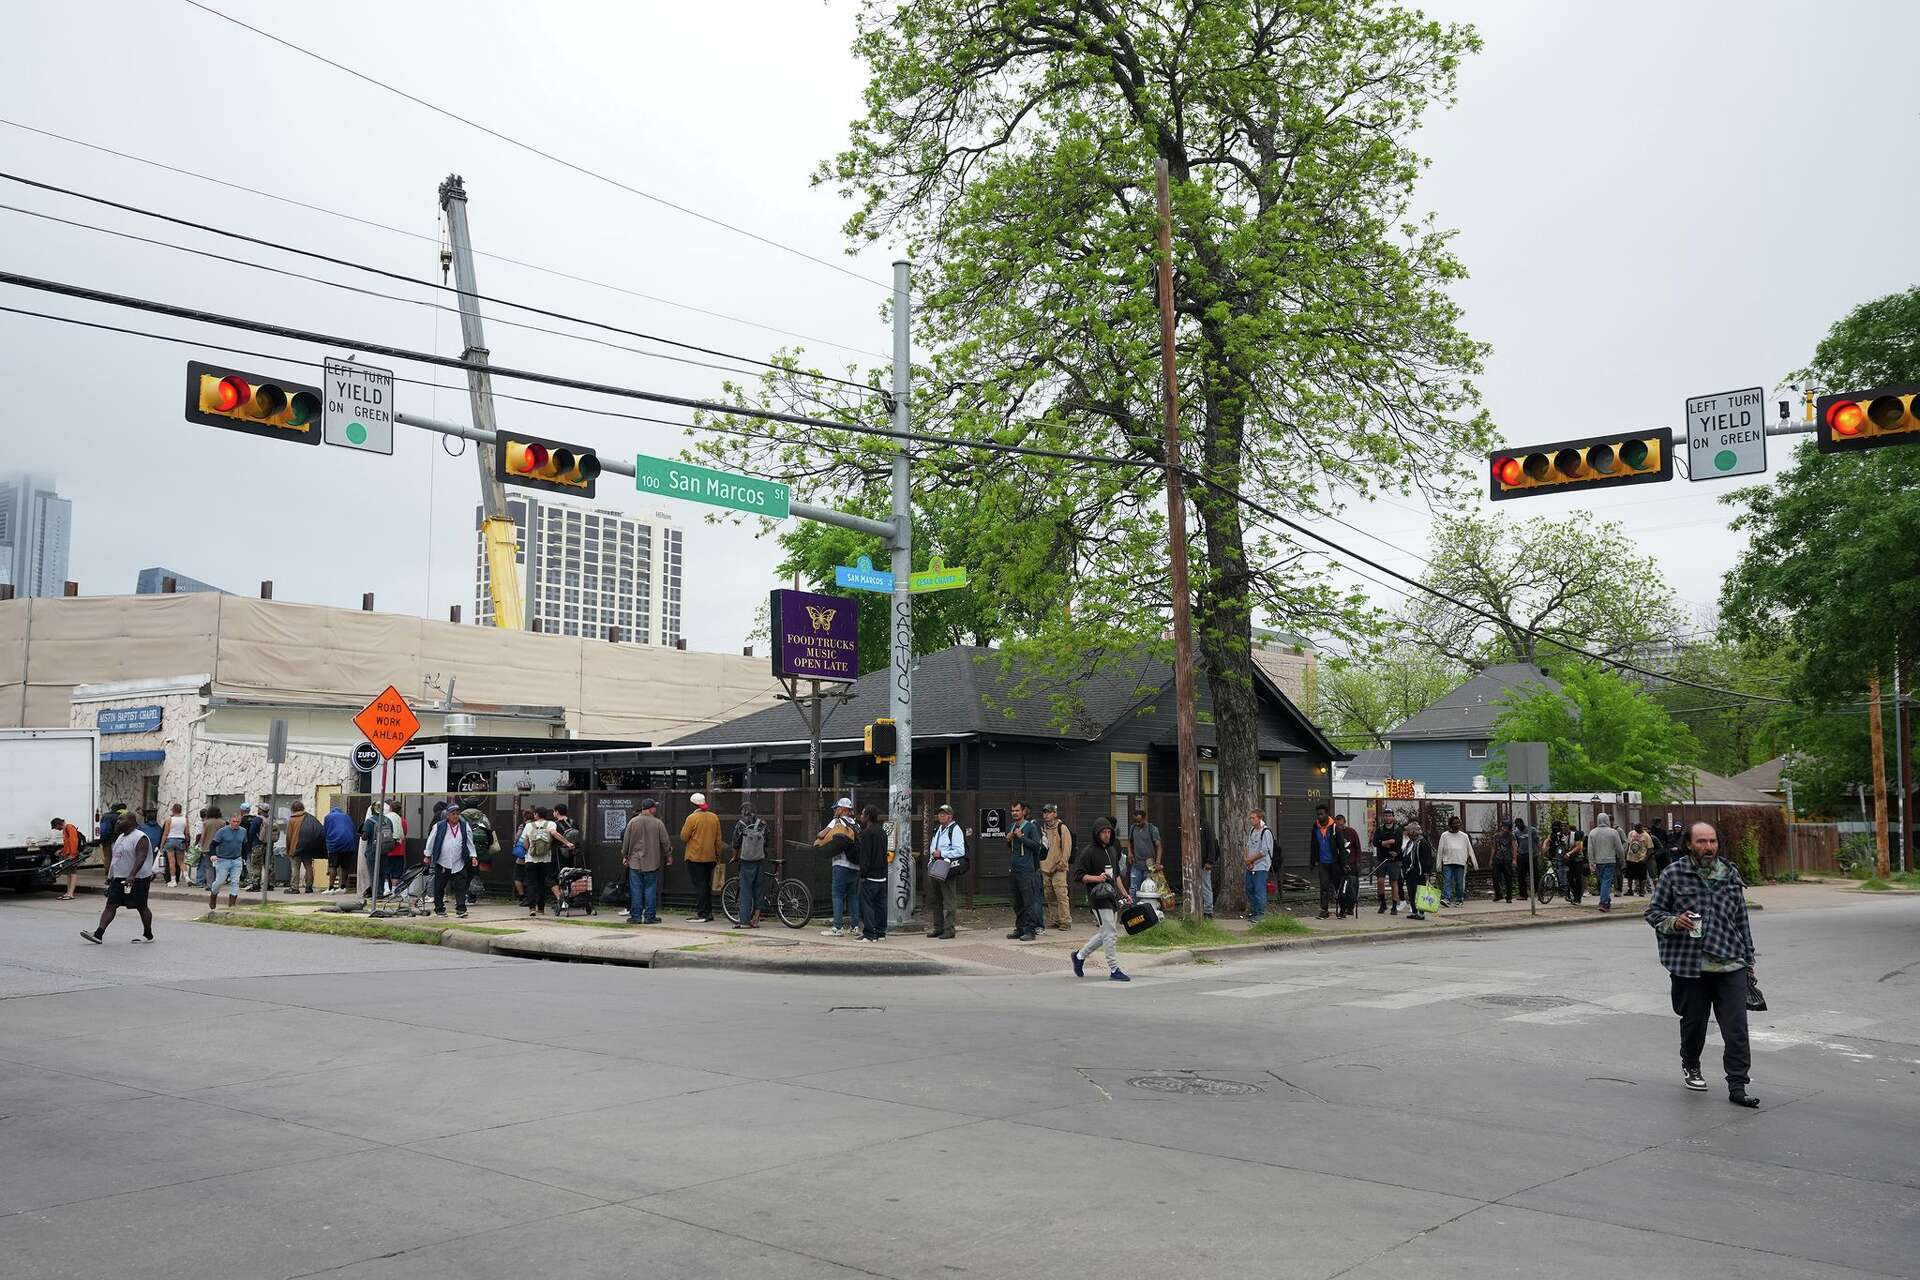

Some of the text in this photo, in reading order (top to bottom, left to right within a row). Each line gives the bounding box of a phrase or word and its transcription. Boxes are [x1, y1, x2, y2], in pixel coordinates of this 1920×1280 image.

[327, 362, 390, 387] LEFT TURN
[336, 380, 383, 405] YIELD
[329, 400, 389, 422] ON GREEN
[1689, 392, 1760, 414] LEFT TURN
[1699, 410, 1751, 433] YIELD
[1692, 429, 1760, 450] ON GREEN
[642, 470, 785, 506] 100 San Marcos St
[847, 573, 860, 583] SAN
[860, 575, 884, 586] MARCOS
[786, 633, 855, 651] FOOD TRUCKS
[806, 647, 837, 660] MUSIC
[794, 656, 849, 672] OPEN LATE
[117, 711, 138, 722] BAPTIST
[140, 709, 158, 720] CHAPEL
[377, 703, 402, 714] ROAD
[376, 716, 401, 727] WORK
[357, 751, 377, 759] ZUFO
